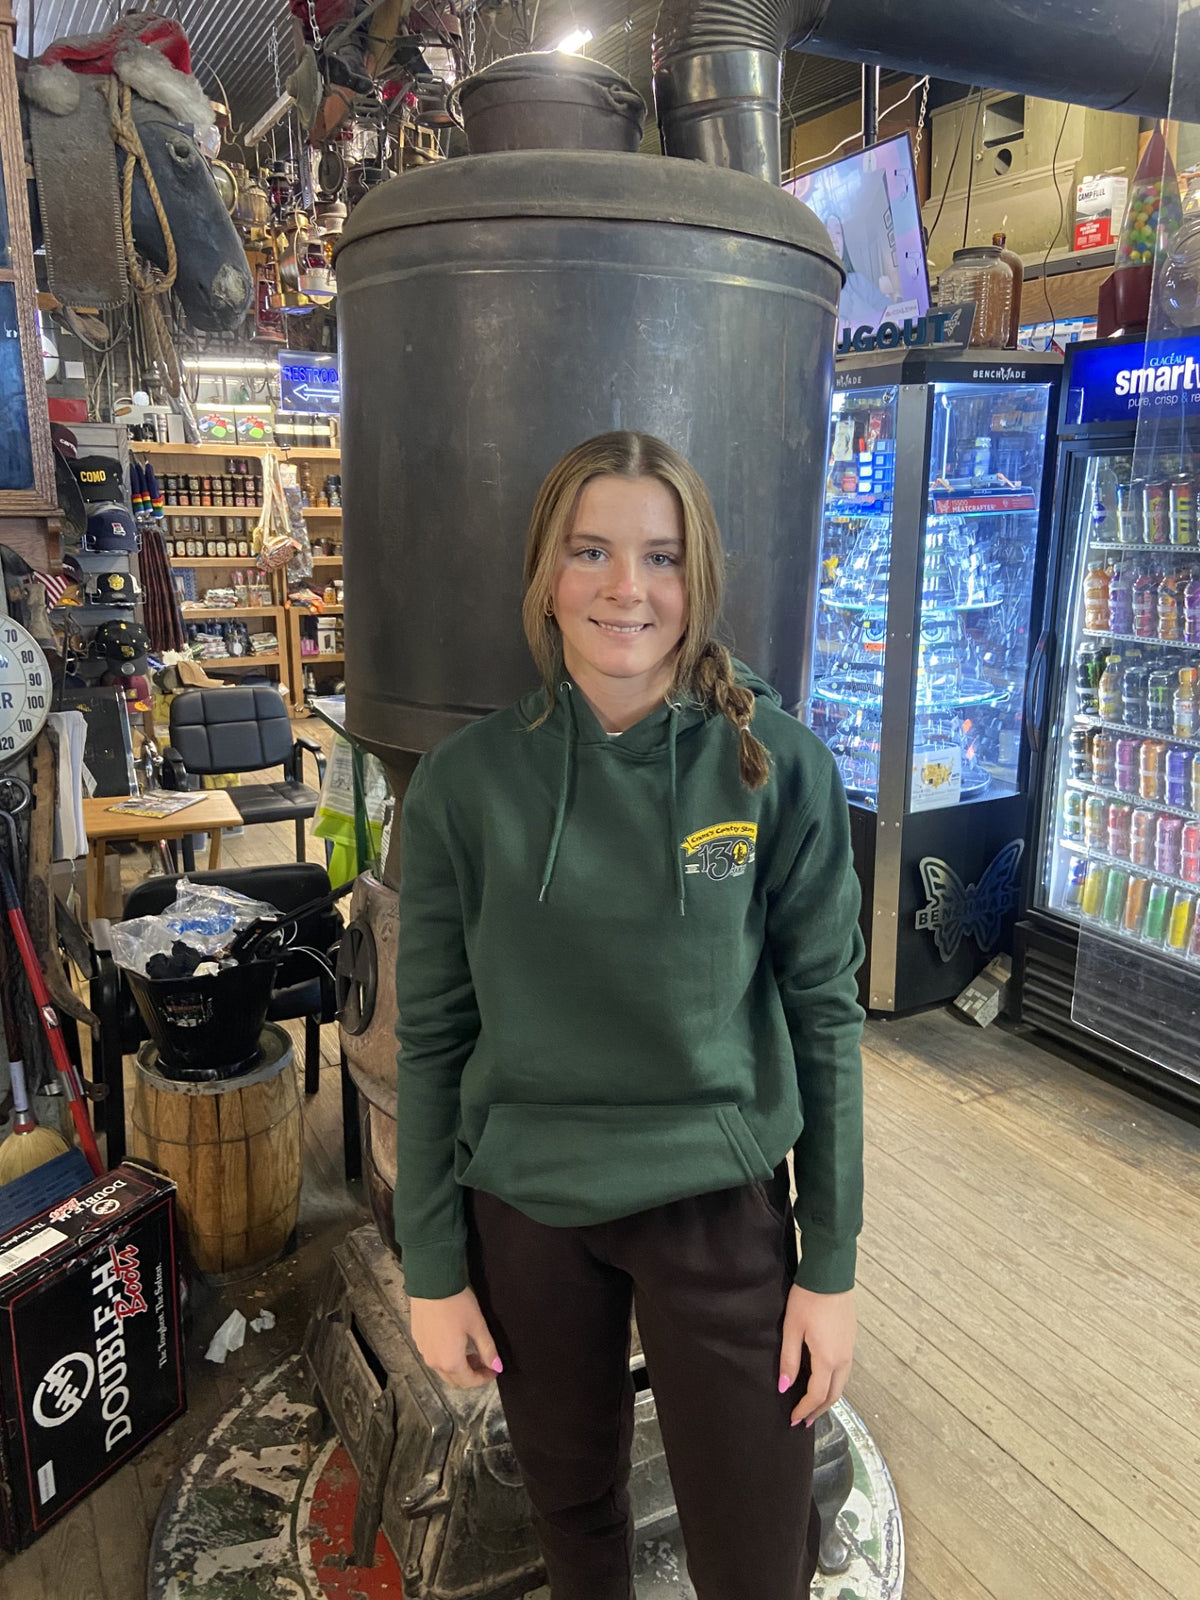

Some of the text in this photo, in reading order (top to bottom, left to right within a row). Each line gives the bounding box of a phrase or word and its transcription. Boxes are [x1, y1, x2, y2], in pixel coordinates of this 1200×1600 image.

[1078, 190, 1093, 201] CAMP
[973, 367, 1026, 381] BENCHMADE
[1154, 393, 1178, 406] crisp
[80, 470, 106, 483] COMO
[4, 629, 18, 643] 70
[21, 650, 35, 664] 80
[29, 673, 42, 687] 90
[27, 695, 45, 710] 100
[18, 718, 33, 733] 110
[109, 1244, 148, 1321] Boots
[91, 1260, 133, 1452] DOUBLE-H
